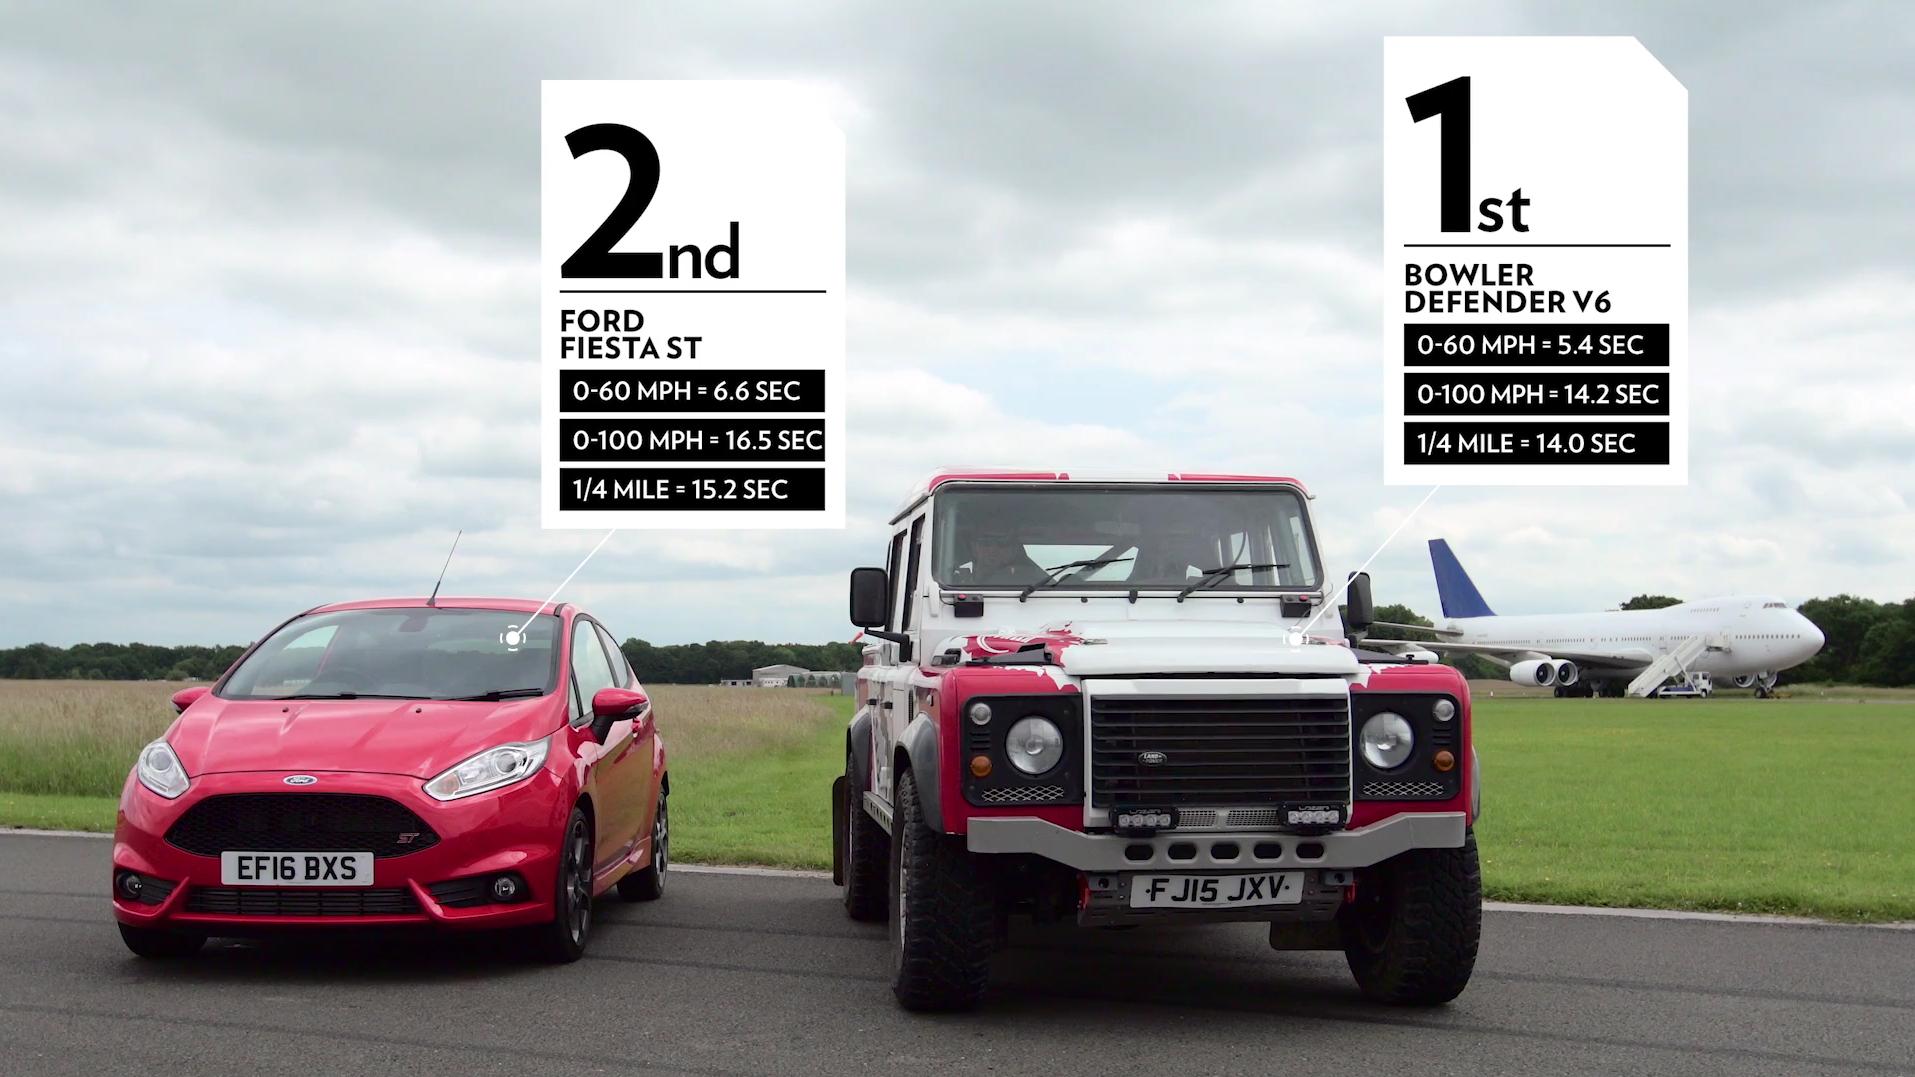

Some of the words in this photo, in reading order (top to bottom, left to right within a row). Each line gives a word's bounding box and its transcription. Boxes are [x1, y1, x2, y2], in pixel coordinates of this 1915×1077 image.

[396, 832, 420, 844] ST
[238, 856, 296, 880] EF16
[304, 856, 356, 880] BXS
[1150, 878, 1219, 902] FJ15
[1227, 875, 1285, 901] JXV
